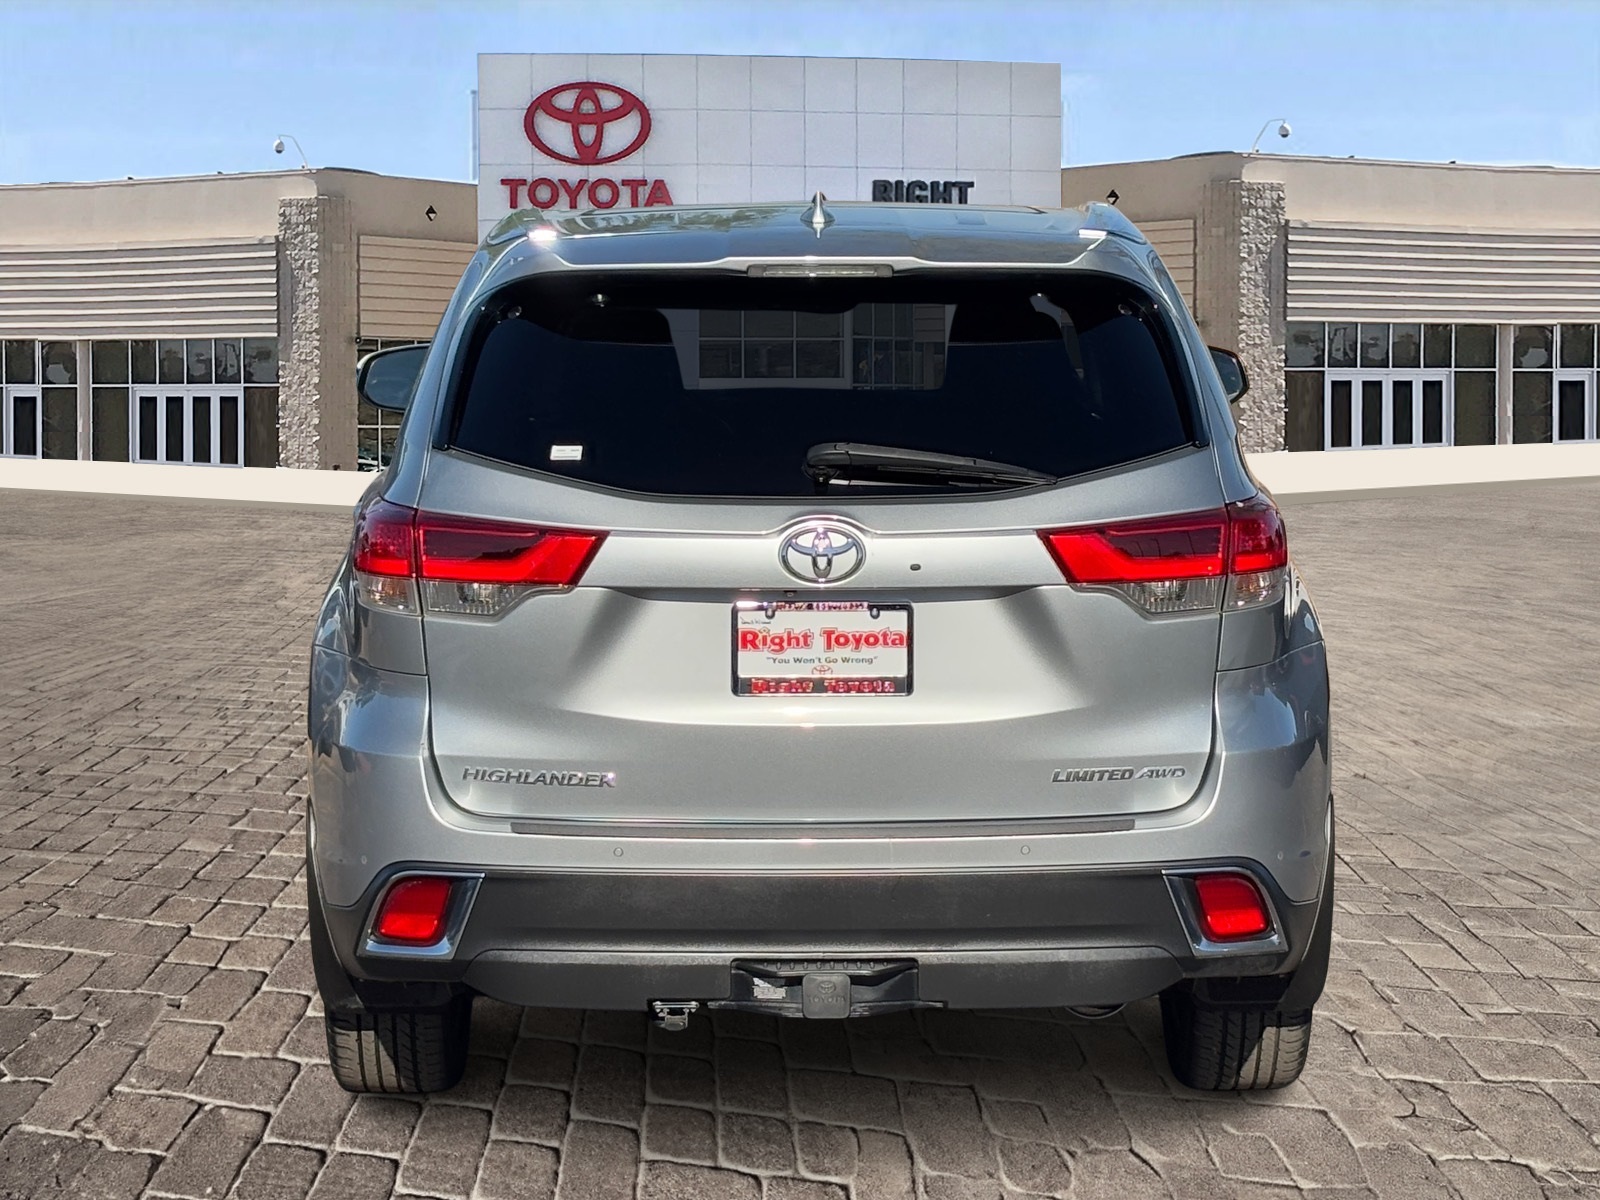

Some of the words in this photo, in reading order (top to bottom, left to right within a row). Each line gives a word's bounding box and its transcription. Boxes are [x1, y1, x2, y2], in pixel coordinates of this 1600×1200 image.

[500, 178, 673, 209] TOYOTA
[872, 179, 975, 204] RIGHT
[738, 627, 813, 654] Right
[820, 627, 907, 652] Toyota
[793, 656, 822, 664] Won't
[825, 656, 838, 664] Go
[462, 766, 616, 788] HIGHLANDER
[1052, 767, 1134, 783] LIMITED
[1136, 766, 1186, 780] AWD
